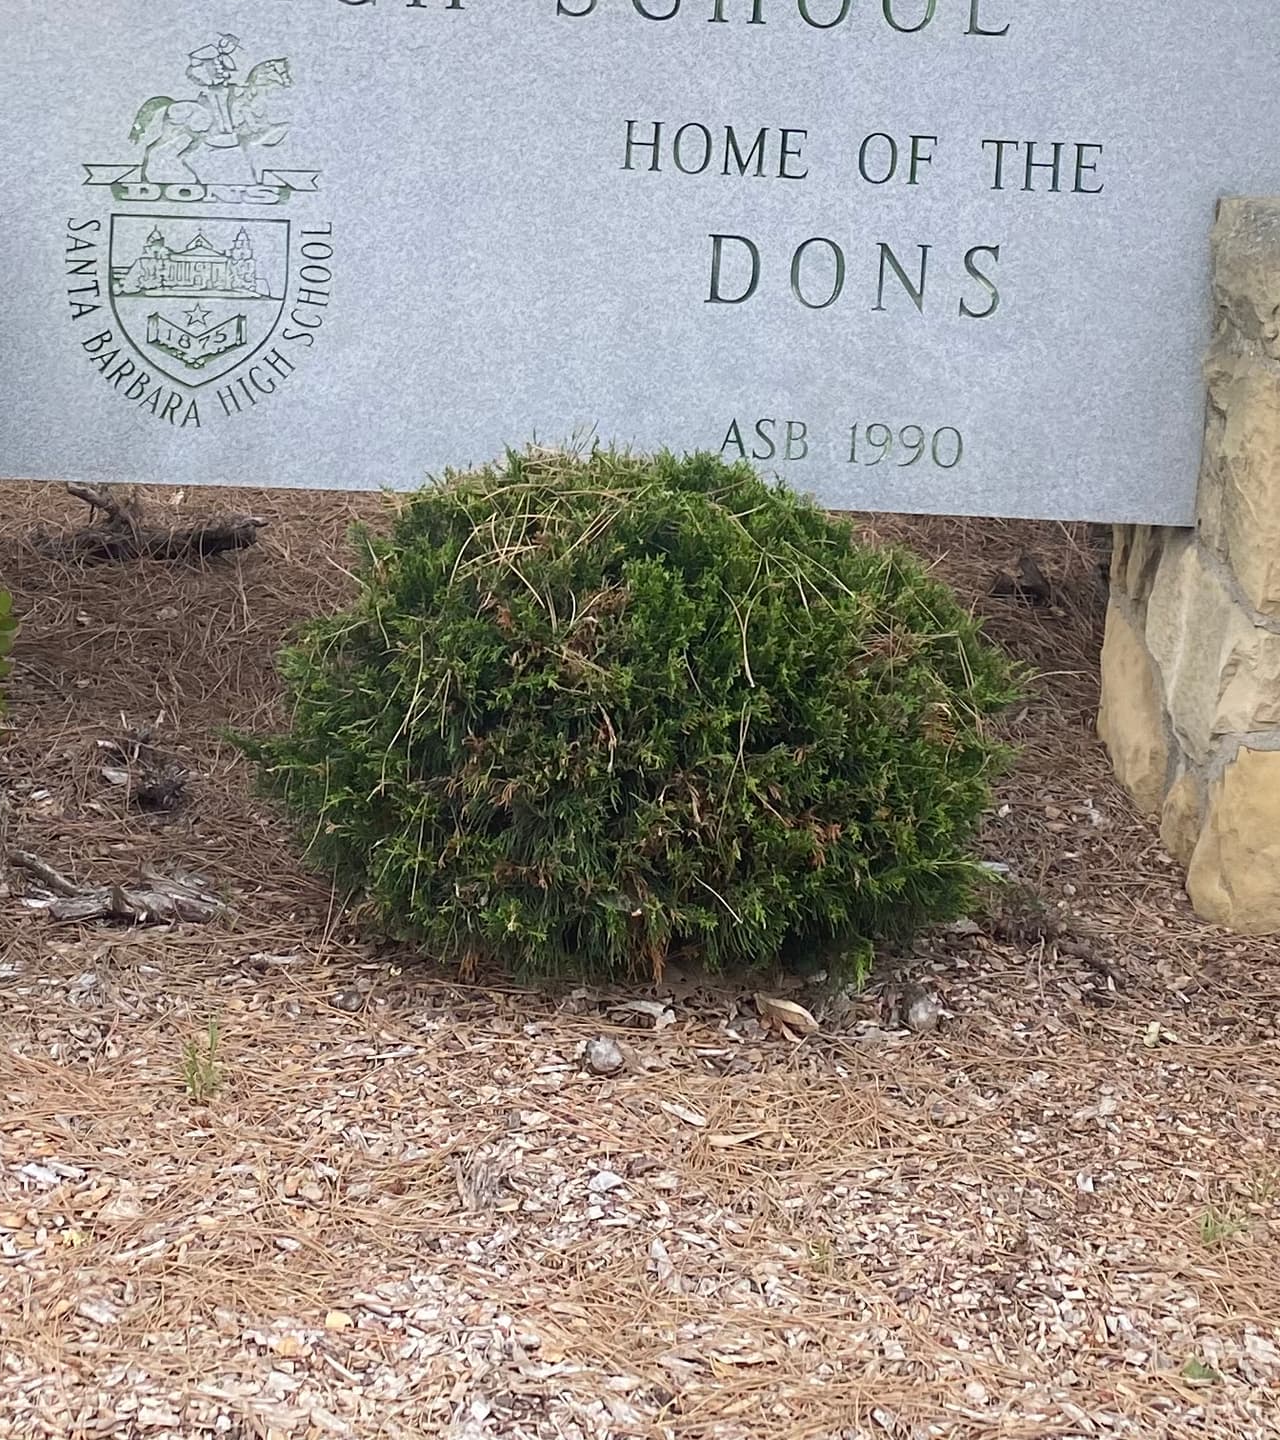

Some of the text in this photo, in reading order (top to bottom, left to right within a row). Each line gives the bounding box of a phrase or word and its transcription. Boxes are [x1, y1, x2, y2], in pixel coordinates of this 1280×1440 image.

[620, 119, 1105, 194] HOME OF THE
[119, 182, 282, 205] DONS
[703, 233, 1000, 318] DONS
[65, 217, 334, 428] SANTA BARBARA HIGH SCHOOL
[164, 328, 228, 350] 1875
[720, 417, 964, 469] ASB 1990
